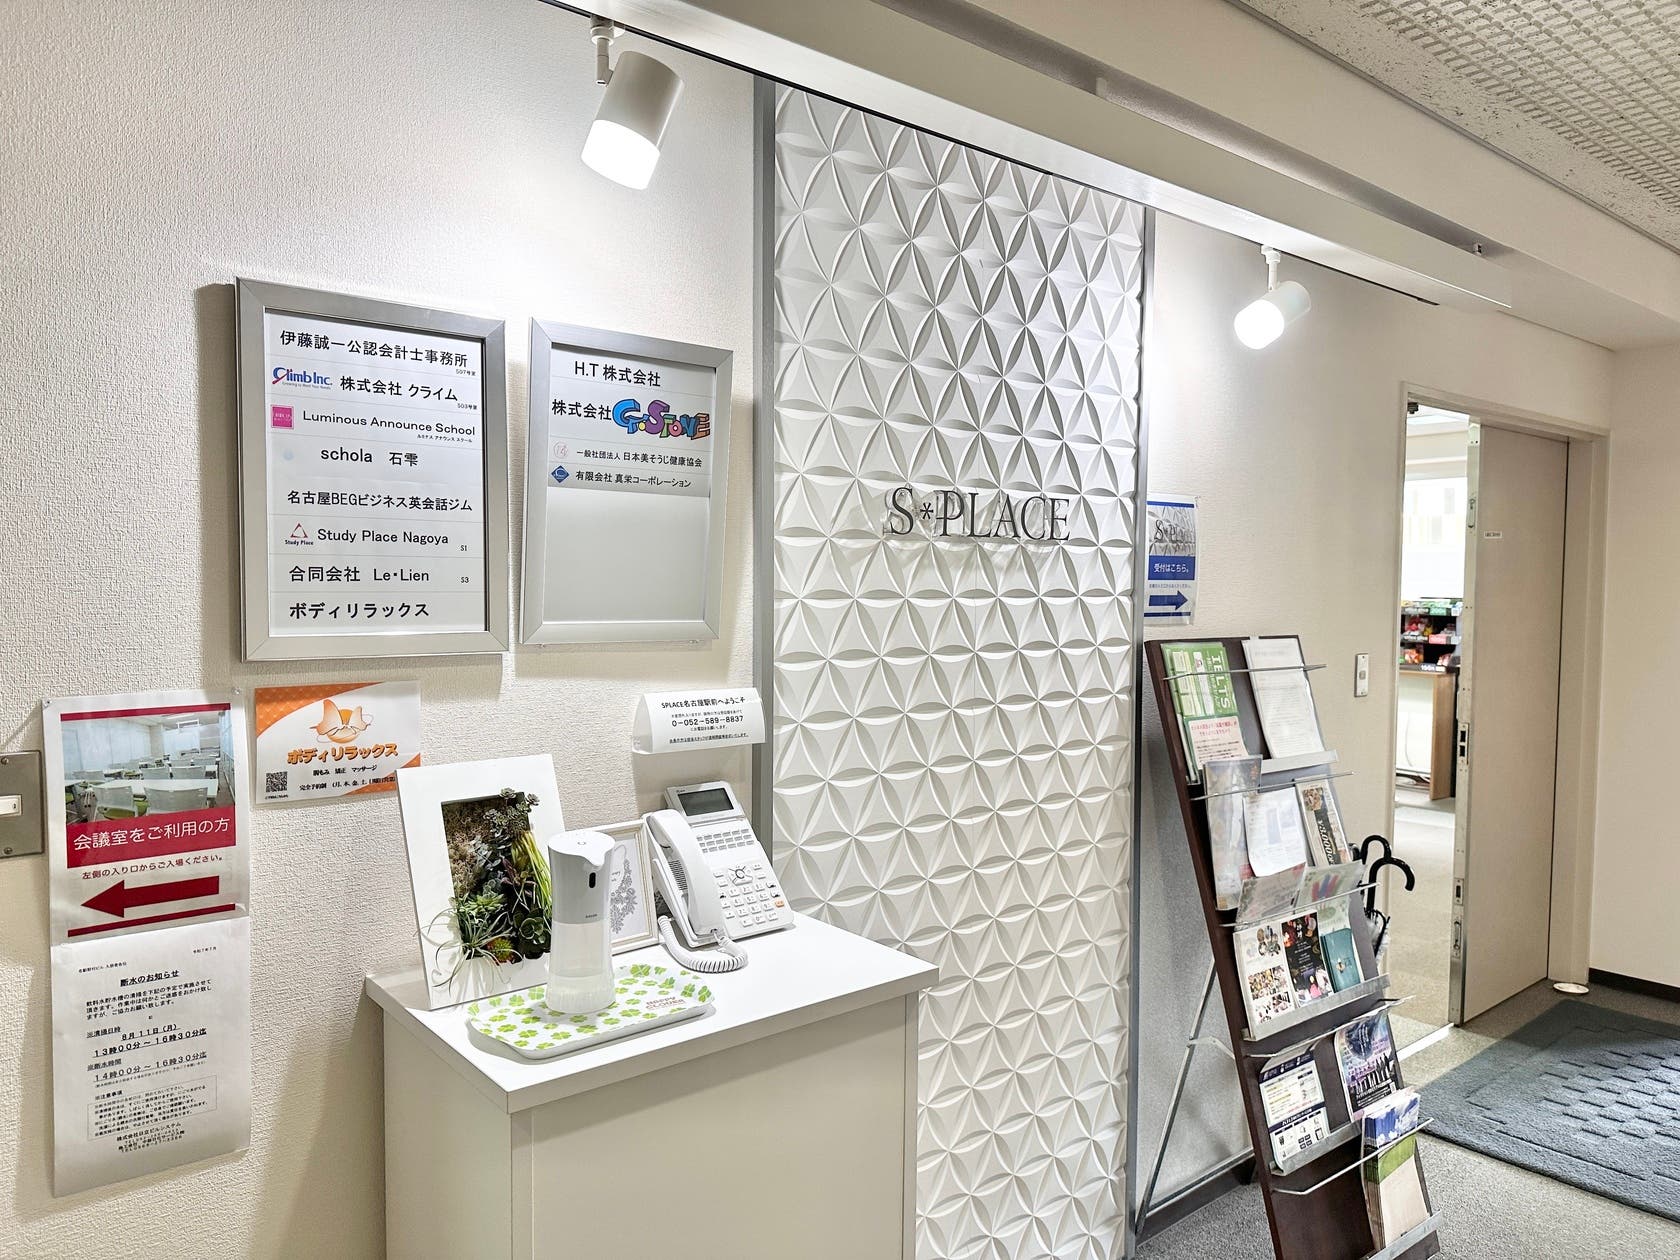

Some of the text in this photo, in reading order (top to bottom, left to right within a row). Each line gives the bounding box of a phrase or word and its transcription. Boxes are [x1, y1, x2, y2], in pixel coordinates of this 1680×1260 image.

[280, 331, 467, 367] 伊藤誠一公認会計士事務所
[574, 361, 661, 387] H.T 株式会社
[340, 376, 402, 396] 株式会社
[408, 383, 458, 401] クライム
[552, 399, 612, 420] 株式会社
[303, 410, 367, 426] Luminous
[370, 417, 432, 432] Announce
[435, 423, 475, 436] School
[321, 447, 418, 467] schola 石雫
[577, 449, 703, 468] 一般社団法人 日本美そうじ健康協会
[576, 470, 692, 488] 有限会社 真栄コーポレーション
[287, 490, 473, 512] 名古屋BEGビジネス英会話ジム
[317, 529, 449, 545] Study Place Nagoya
[289, 566, 361, 583] 合同会社
[289, 602, 429, 620] ボディリラックス
[1211, 655, 1231, 708] IELTS
[287, 743, 399, 765] ボディリラックス
[73, 818, 230, 851] 会議室をご利用の方
[82, 855, 223, 880] 左側の入り口からご入場ください。
[120, 970, 180, 987] 断水のお知らせ
